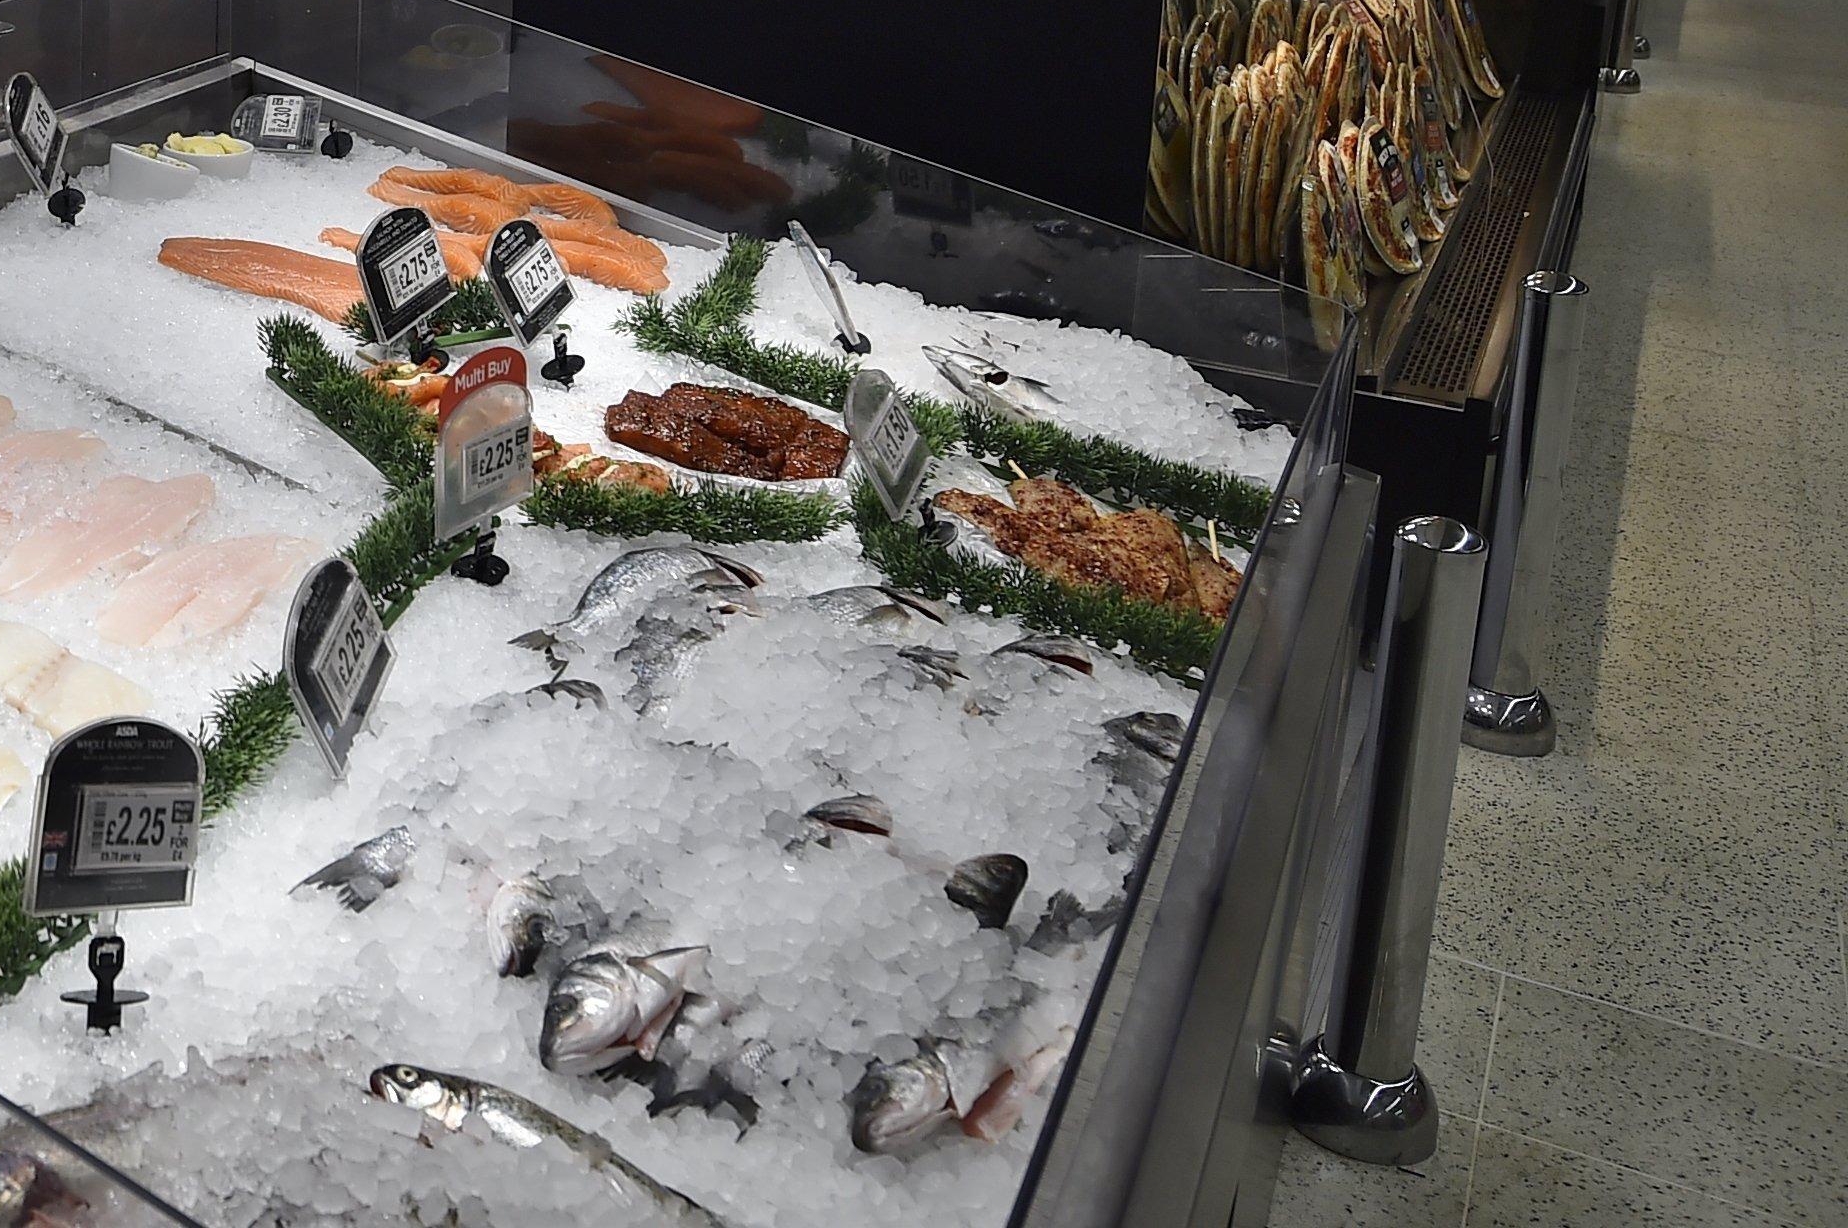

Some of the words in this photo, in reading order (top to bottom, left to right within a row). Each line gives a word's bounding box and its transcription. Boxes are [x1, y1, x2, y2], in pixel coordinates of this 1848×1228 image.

[399, 252, 428, 289] £2.75
[524, 259, 549, 296] £2.75
[454, 365, 486, 394] Multi
[487, 357, 512, 379] Buy
[886, 405, 909, 459] £1.50
[480, 437, 513, 477] £2.25
[339, 618, 365, 687] £2.25
[115, 725, 139, 737] ASDA
[105, 806, 167, 846] £2.25
[170, 837, 189, 849] FOR
